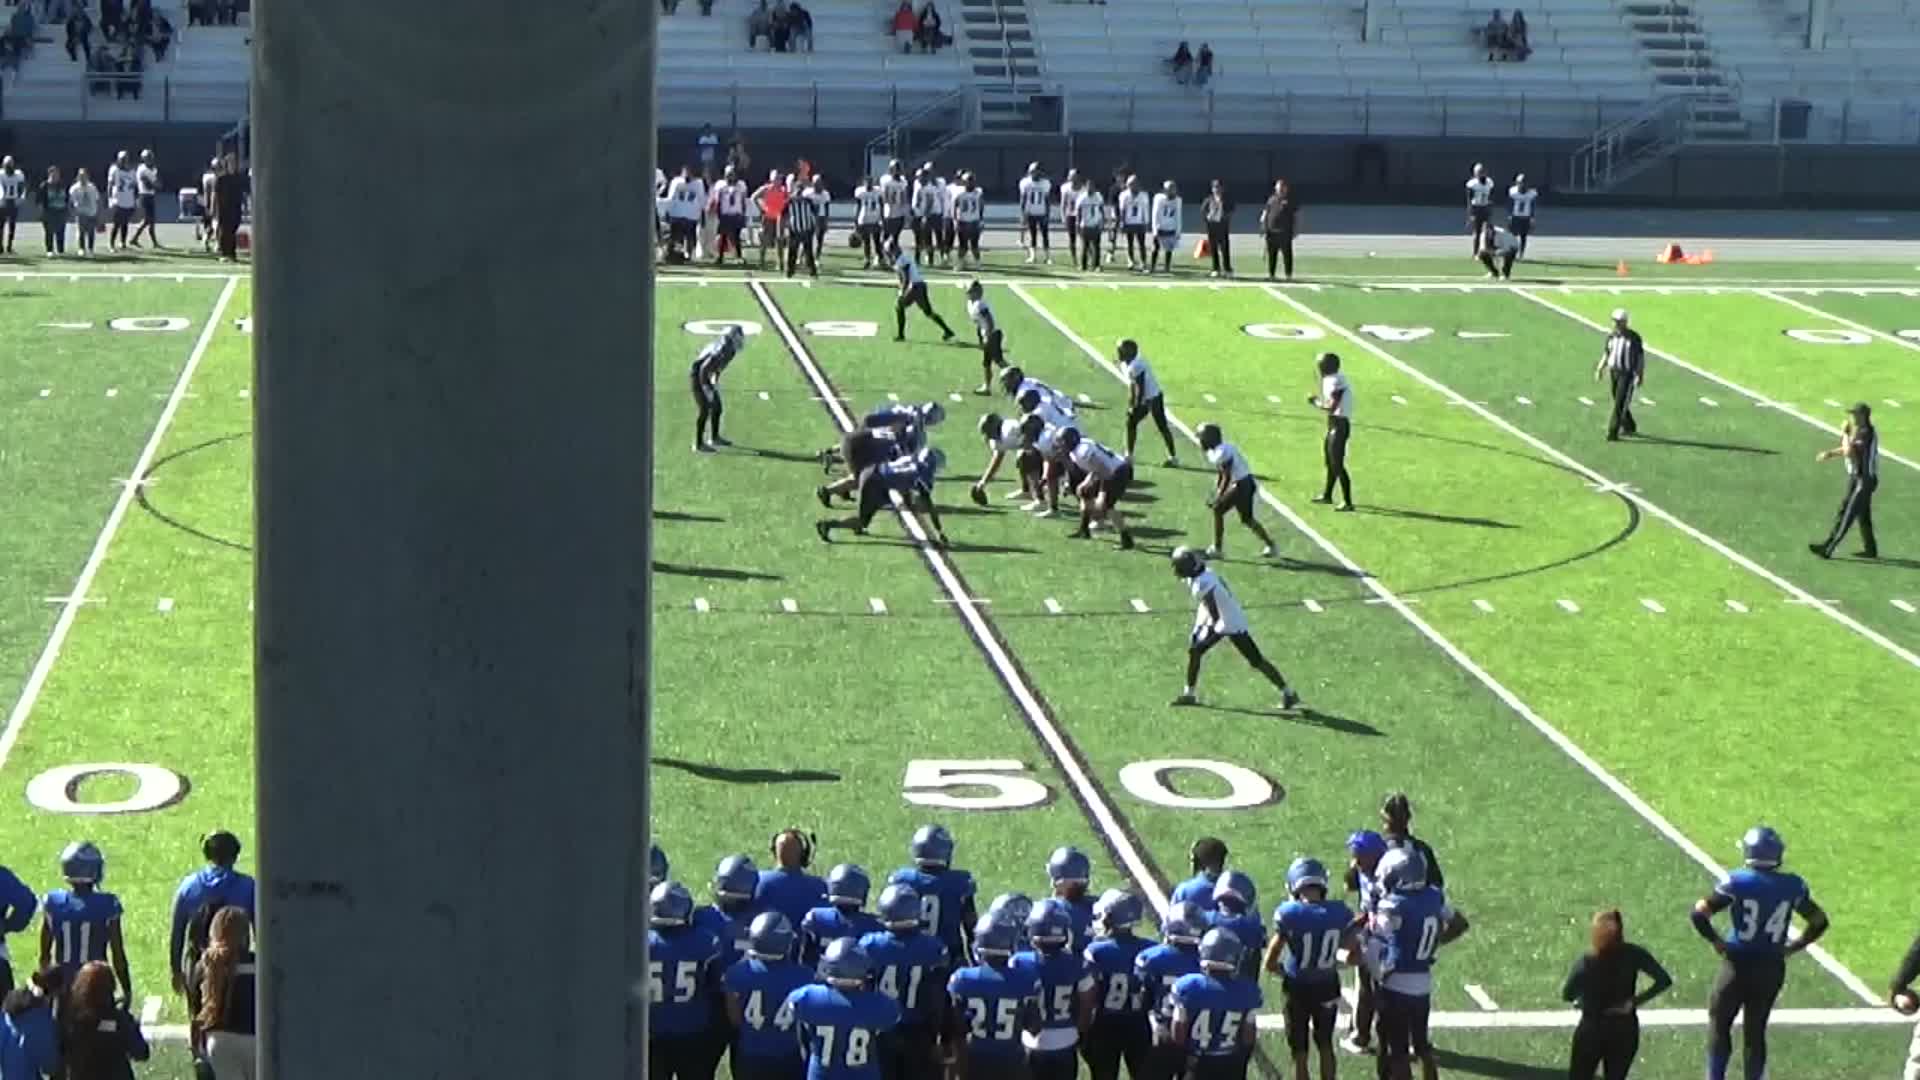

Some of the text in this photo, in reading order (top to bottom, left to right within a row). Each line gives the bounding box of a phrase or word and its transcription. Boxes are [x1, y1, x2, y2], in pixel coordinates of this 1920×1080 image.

[901, 759, 1280, 811] 50
[62, 921, 91, 963] 11
[1738, 899, 1791, 943] 34
[1300, 928, 1341, 969] 10
[879, 964, 922, 1008] 41
[744, 990, 794, 1030] 44
[968, 997, 1018, 1040] 25
[1191, 1008, 1243, 1048] 45
[816, 1025, 871, 1067] 78
